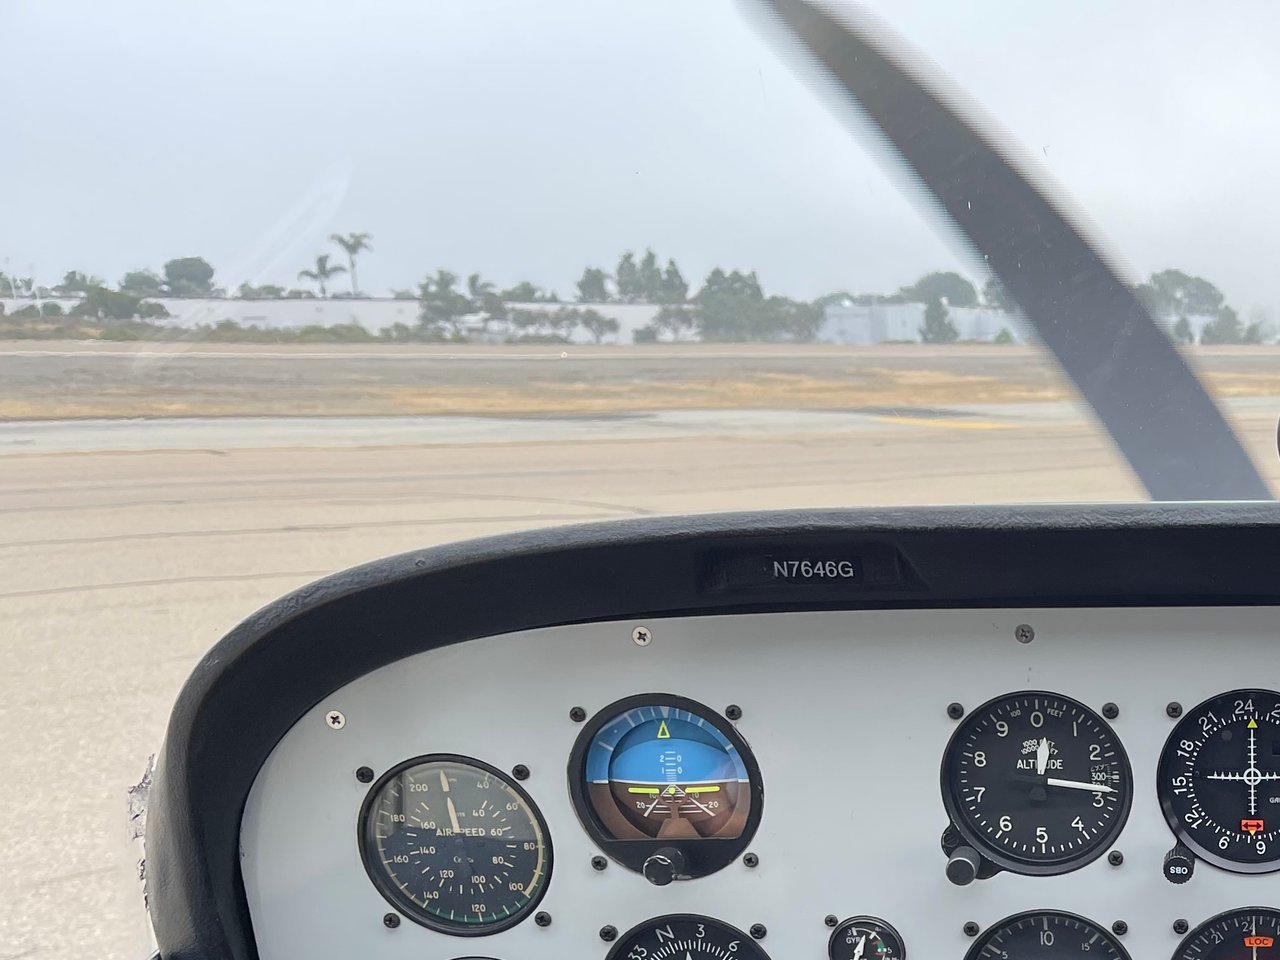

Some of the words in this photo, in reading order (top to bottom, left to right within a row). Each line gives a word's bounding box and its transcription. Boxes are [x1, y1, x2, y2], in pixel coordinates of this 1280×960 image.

[774, 561, 854, 578] N7646G
[1234, 700, 1255, 714] 24
[1030, 711, 1044, 728] 0
[974, 751, 987, 767] 8
[1089, 745, 1102, 761] 2
[410, 784, 428, 792] 200
[1173, 776, 1187, 795] 15
[973, 787, 986, 803] 7
[1036, 827, 1049, 843] 5
[1169, 866, 1189, 874] OBS
[509, 883, 524, 891] 100
[656, 925, 675, 943] N
[1040, 931, 1054, 946] 10
